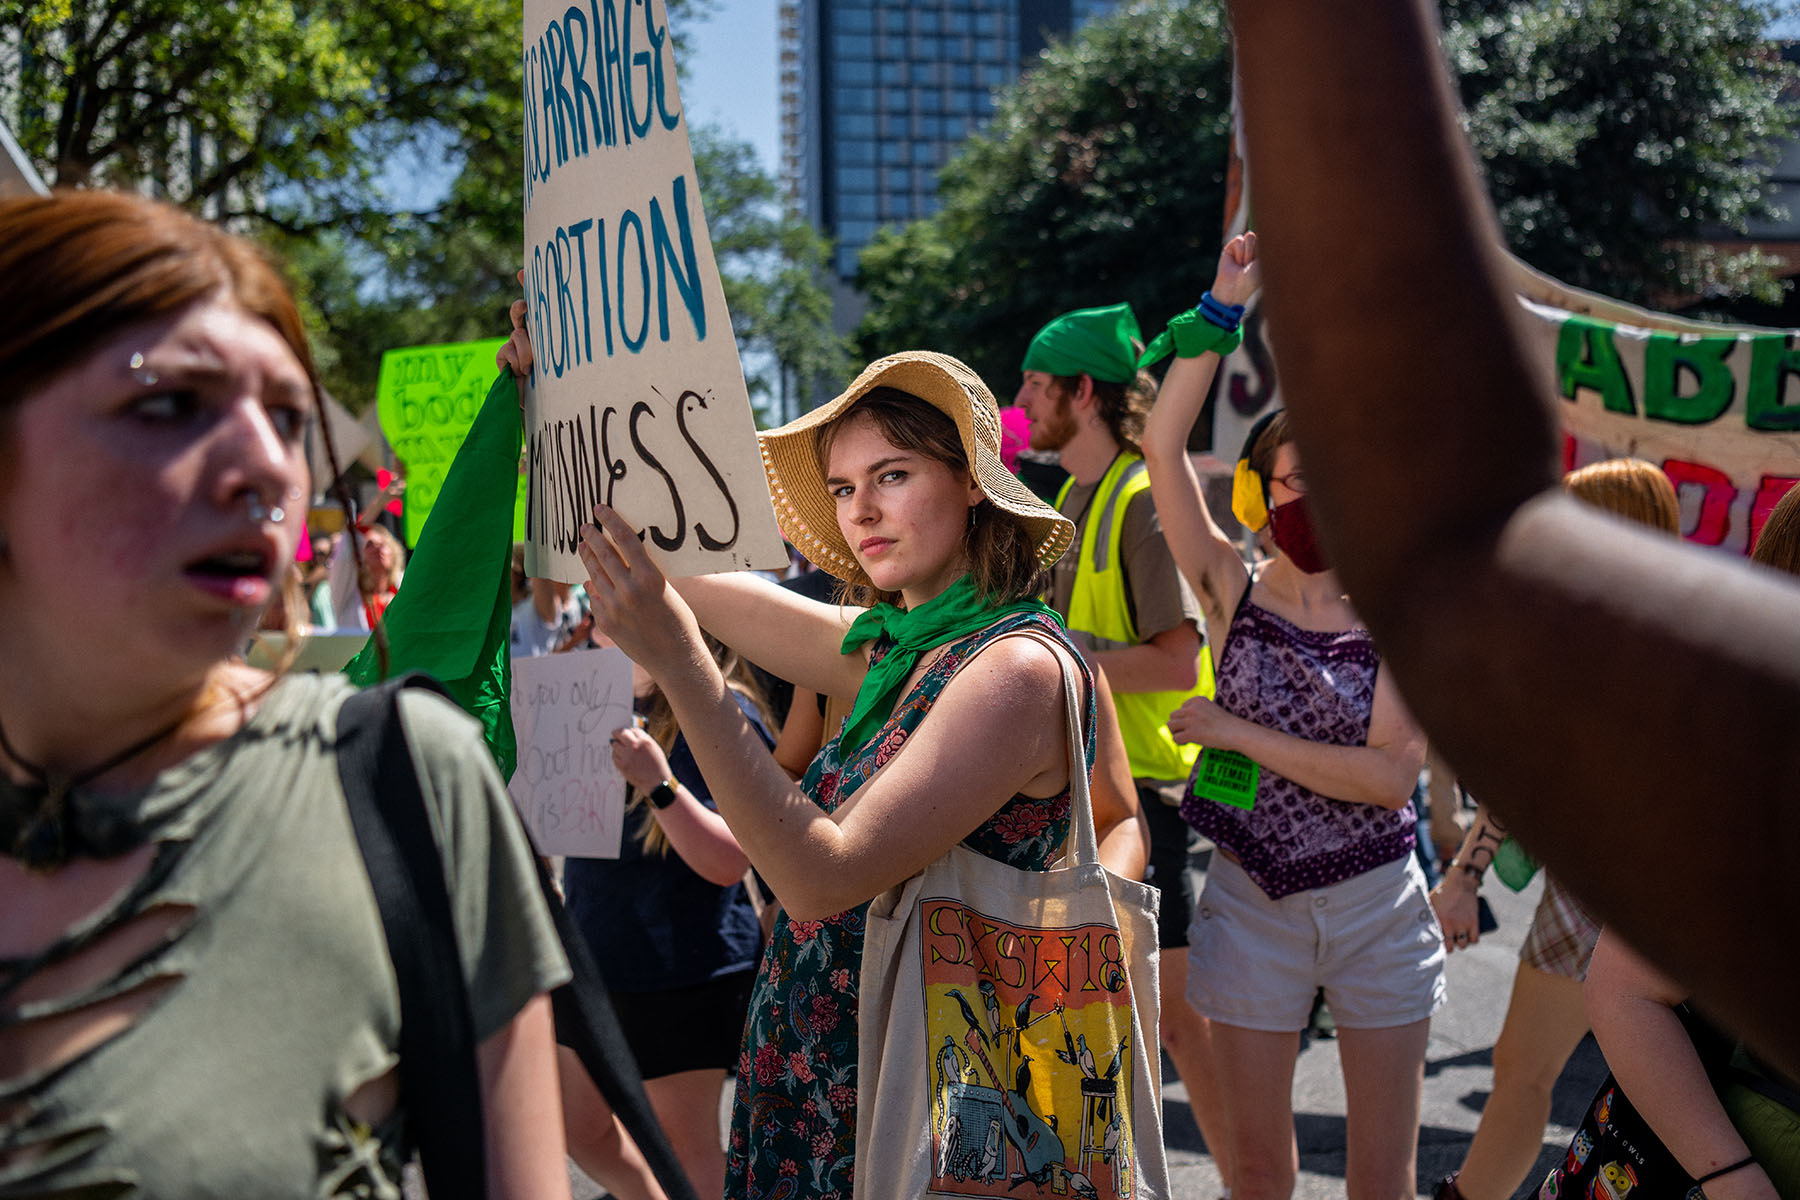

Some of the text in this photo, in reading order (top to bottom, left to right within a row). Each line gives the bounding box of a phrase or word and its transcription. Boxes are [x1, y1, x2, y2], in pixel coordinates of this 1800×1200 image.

[394, 353, 475, 392] my
[393, 377, 488, 432] bod
[1217, 764, 1252, 785] FEMALE
[1622, 1139, 1645, 1165] OWLS
